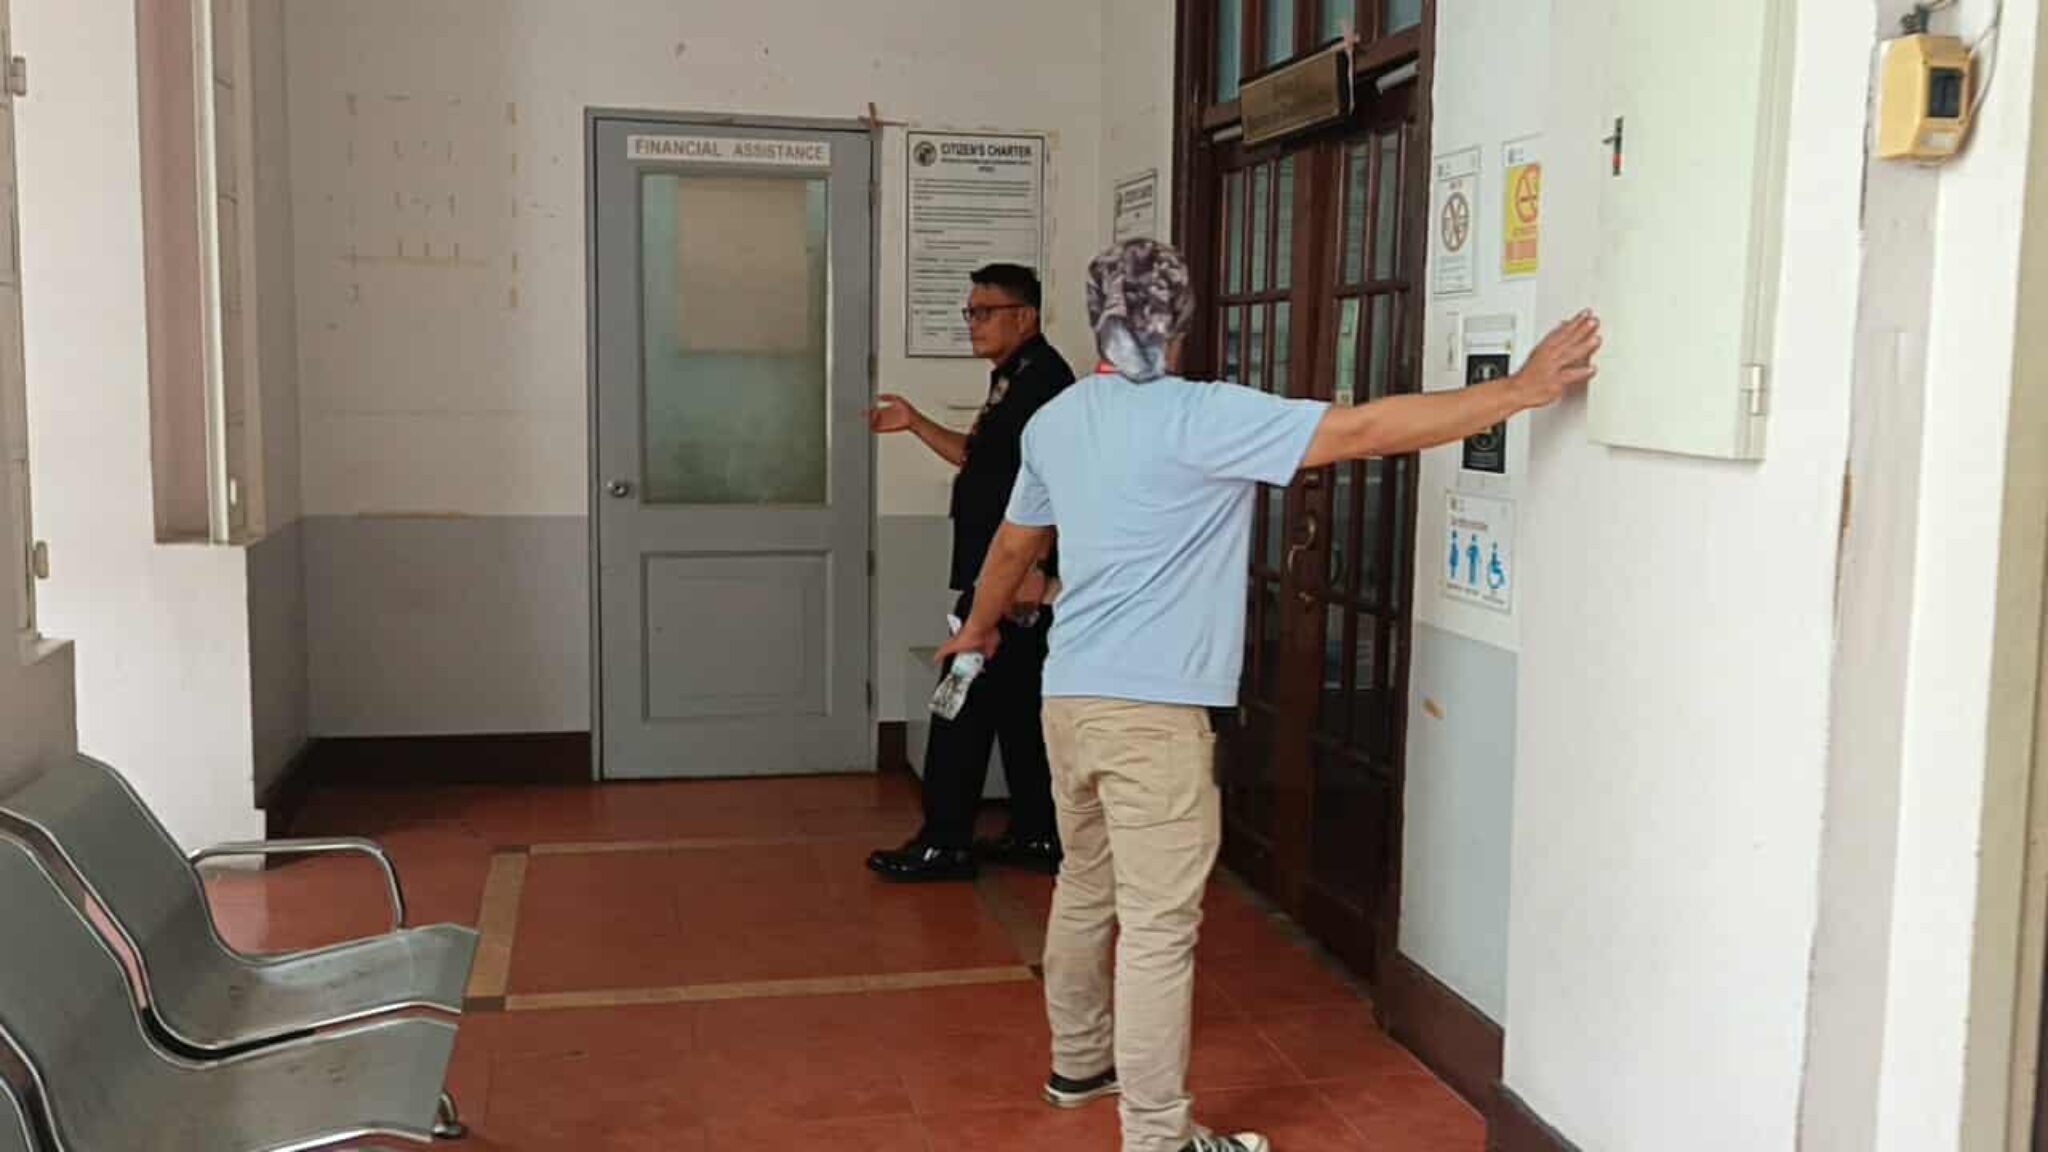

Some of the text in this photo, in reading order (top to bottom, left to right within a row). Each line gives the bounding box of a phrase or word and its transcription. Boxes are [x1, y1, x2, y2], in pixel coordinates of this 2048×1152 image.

[635, 140, 823, 160] FINANCIAL ASSISTANCE
[940, 142, 1032, 158] CITIZEN'S CHARTER
